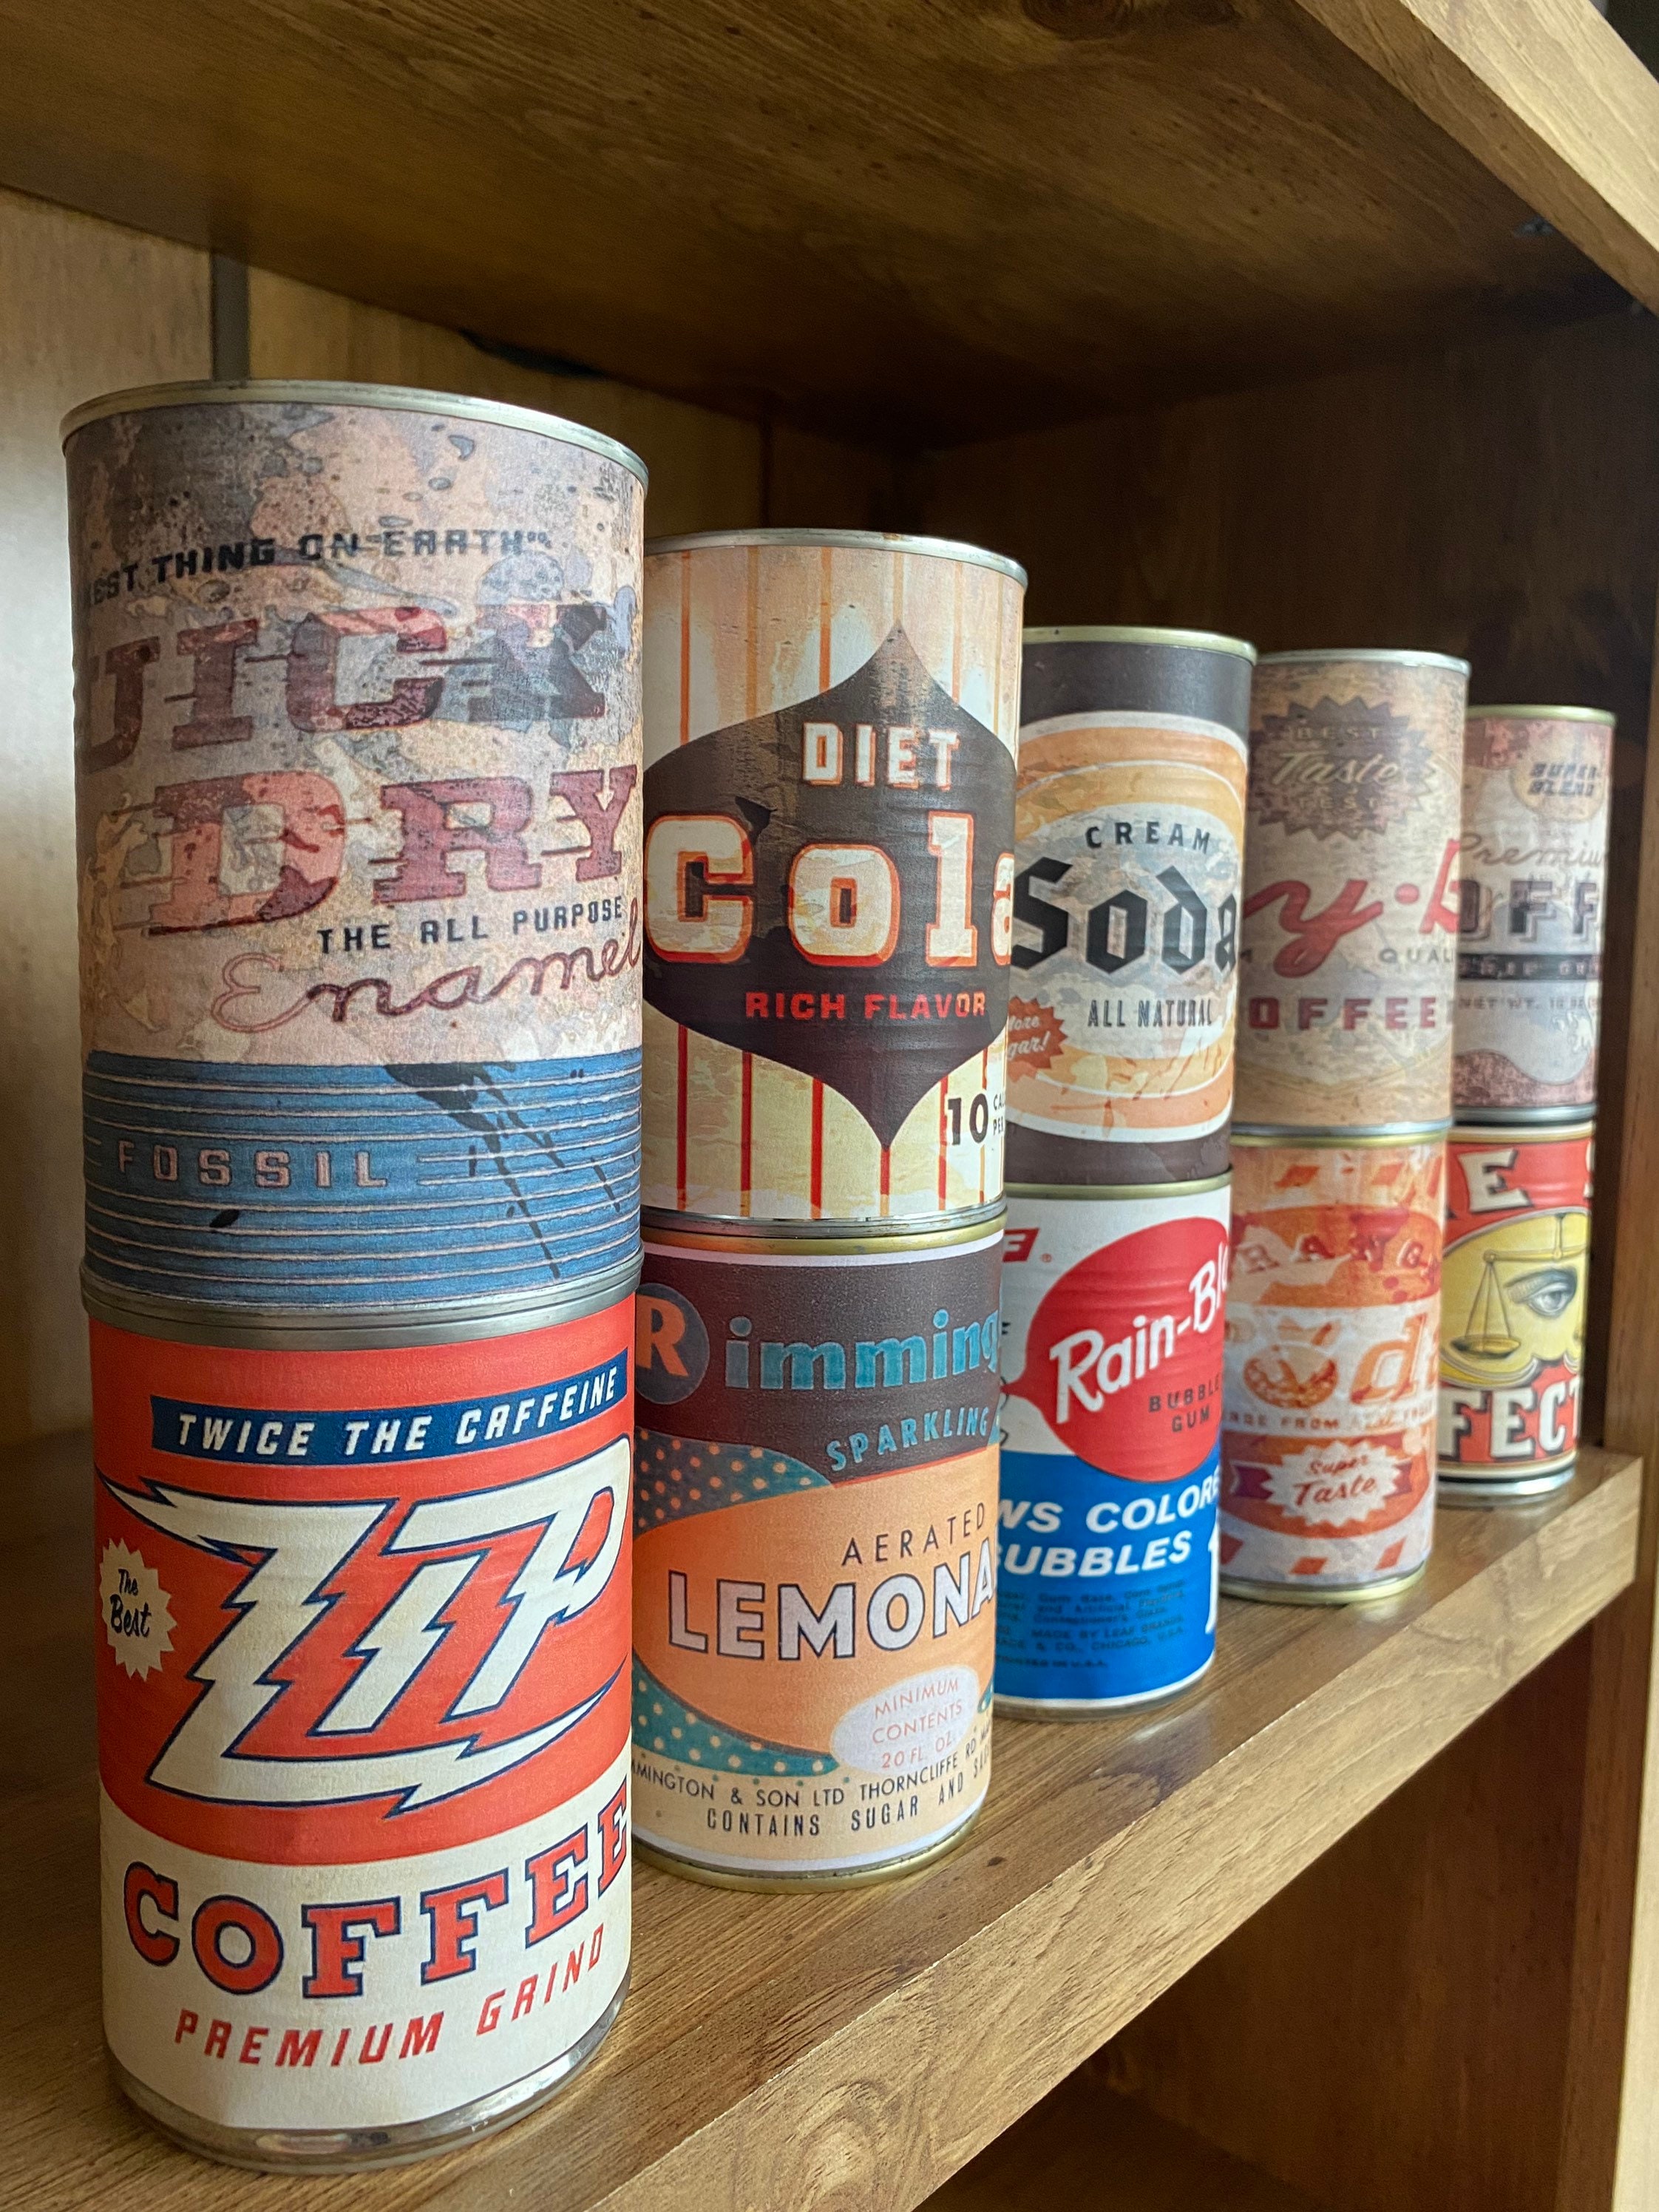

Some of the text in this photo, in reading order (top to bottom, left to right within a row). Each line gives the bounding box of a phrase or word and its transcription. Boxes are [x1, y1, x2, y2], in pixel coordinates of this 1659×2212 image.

[152, 538, 274, 583] THING
[299, 532, 358, 560] ON
[802, 722, 962, 791] DIET
[148, 764, 637, 935] DRY
[1086, 821, 1210, 854] CREAM
[316, 896, 622, 954] THE ALL PURPOSE
[1011, 856, 1237, 977] Soda
[211, 898, 640, 1033] Enamel
[745, 991, 986, 1020] RICH FLAVOR
[1088, 999, 1212, 1027] ALL NATURAL
[1249, 996, 1436, 1031] OFFEE
[948, 1093, 988, 1146] 10
[118, 1140, 387, 1187] FOSSIL
[178, 1366, 619, 1456] TWICE THE CAFFEINE
[1148, 1373, 1221, 1413] BUBBLE
[826, 1406, 989, 1472] SPARKLING
[1172, 1406, 1210, 1433] GUM
[1310, 1454, 1369, 1476] Super
[1293, 1475, 1376, 1507] Taste
[841, 1502, 986, 1567] AERATED
[996, 1530, 1192, 1577] UBBLES
[118, 1569, 138, 1596] The
[668, 1536, 995, 1661] LEMONA
[94, 1434, 631, 1820] ZIP
[109, 1594, 152, 1638] Best
[872, 1698, 963, 1745] CONTENTS
[874, 1677, 960, 1719] MINIMUM
[881, 1731, 952, 1769] 20 FL OZ
[708, 1771, 963, 1837] CONTAINS SUGAR AND
[730, 1787, 743, 1805] &
[756, 1789, 799, 1808] SON
[814, 1788, 845, 1806] LTD
[860, 1750, 958, 1799] THORNCLIFFE
[123, 1776, 627, 1999] COFFEE
[174, 1923, 605, 2067] PREMIUM GRIND
